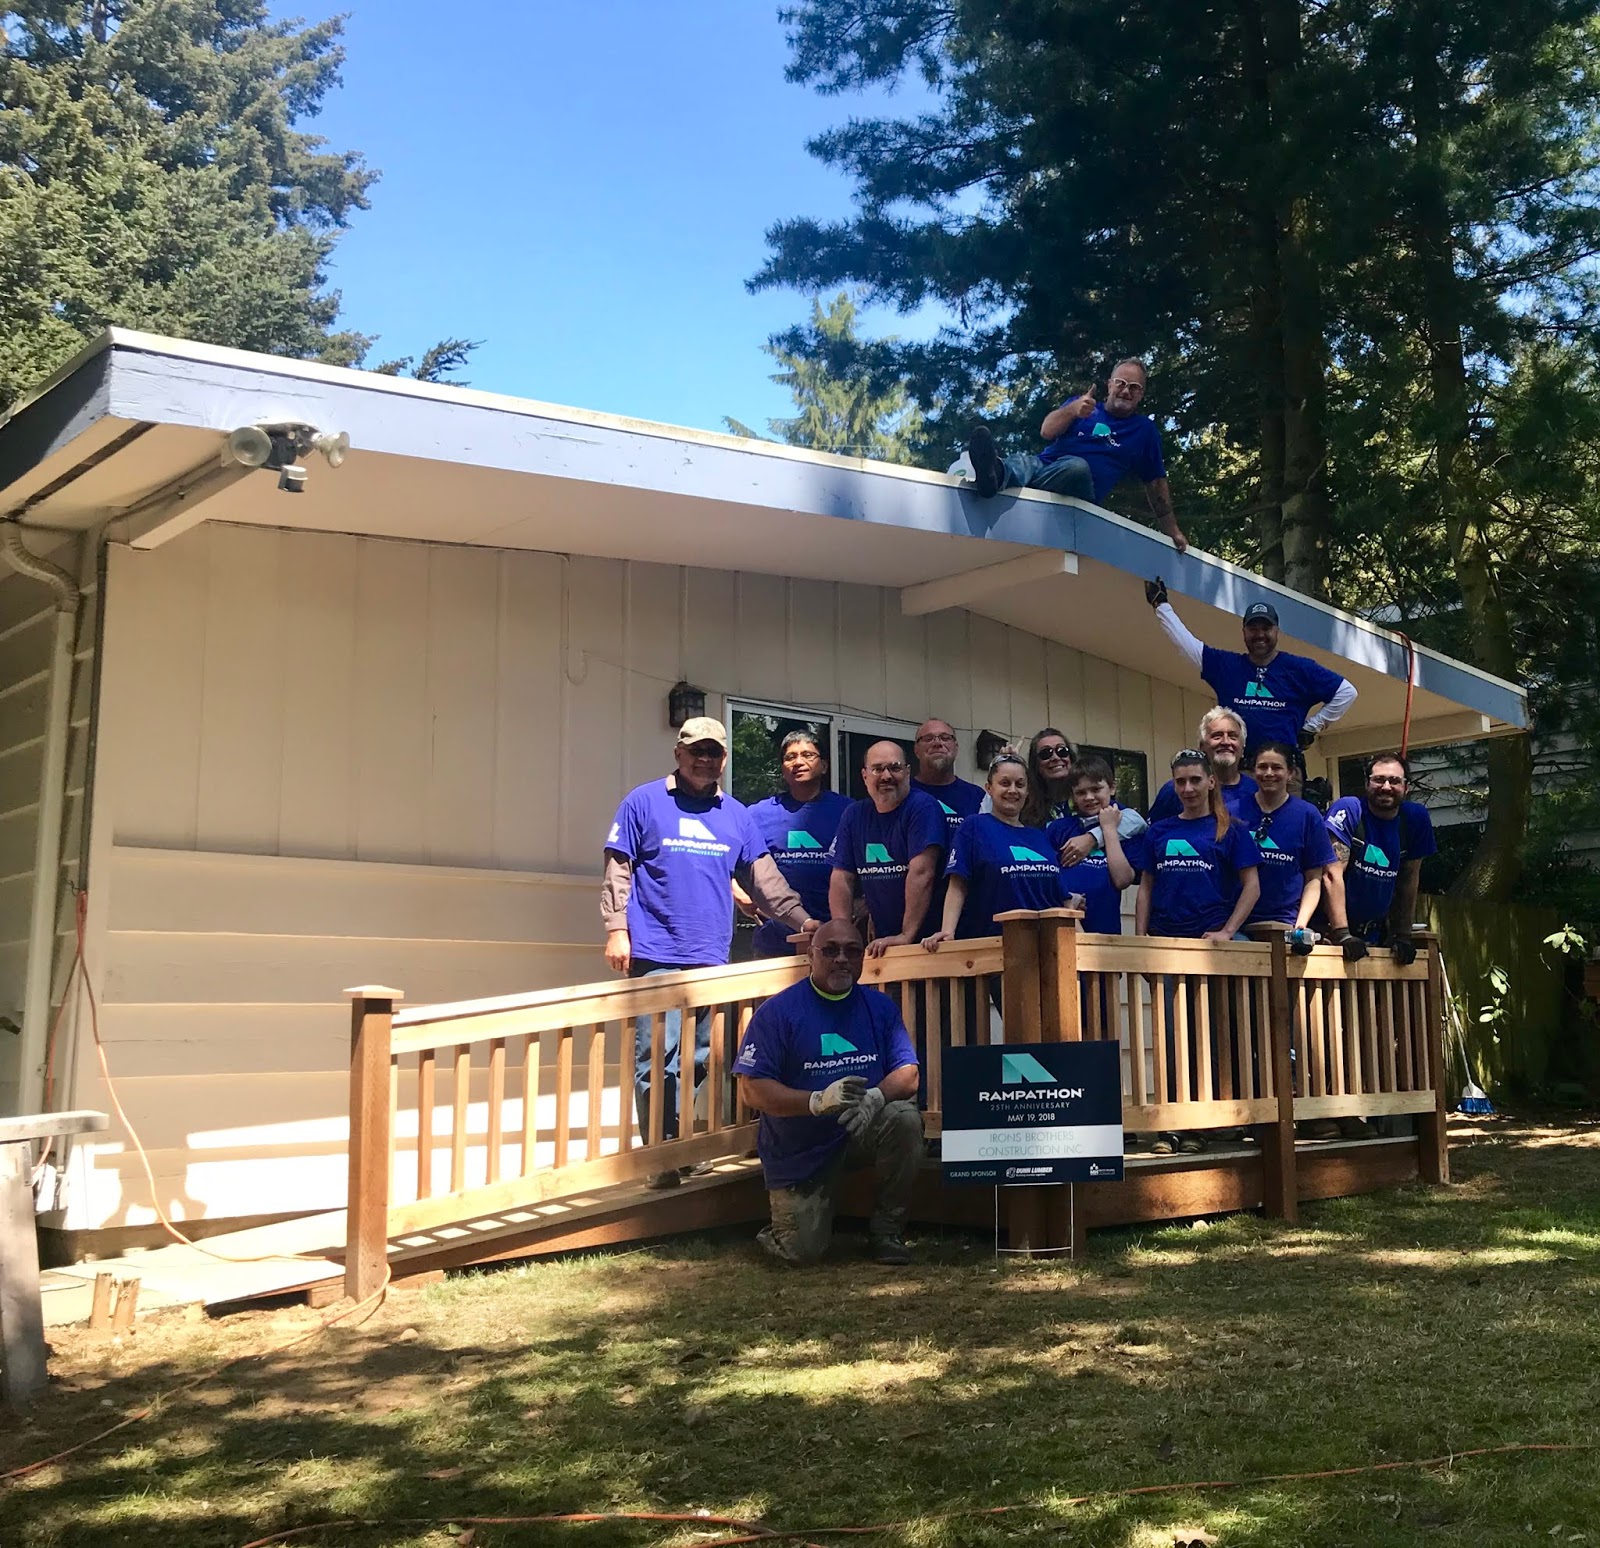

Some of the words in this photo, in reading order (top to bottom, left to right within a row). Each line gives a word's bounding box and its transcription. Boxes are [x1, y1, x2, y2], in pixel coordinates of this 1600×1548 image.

[804, 1054, 877, 1070] RAMPATHON
[979, 1088, 1082, 1101] RAMPATHON
[990, 1103, 1010, 1111] 25TH
[1014, 1101, 1070, 1110] ANNIVERSARY
[1007, 1113, 1025, 1122] MAY
[1027, 1113, 1036, 1122] 19,
[1038, 1112, 1055, 1121] 2018
[989, 1132, 1021, 1142] IRONS
[1025, 1130, 1074, 1142] BROTHERS
[978, 1145, 1059, 1157] CONSTRUCTION
[1063, 1144, 1082, 1154] INC
